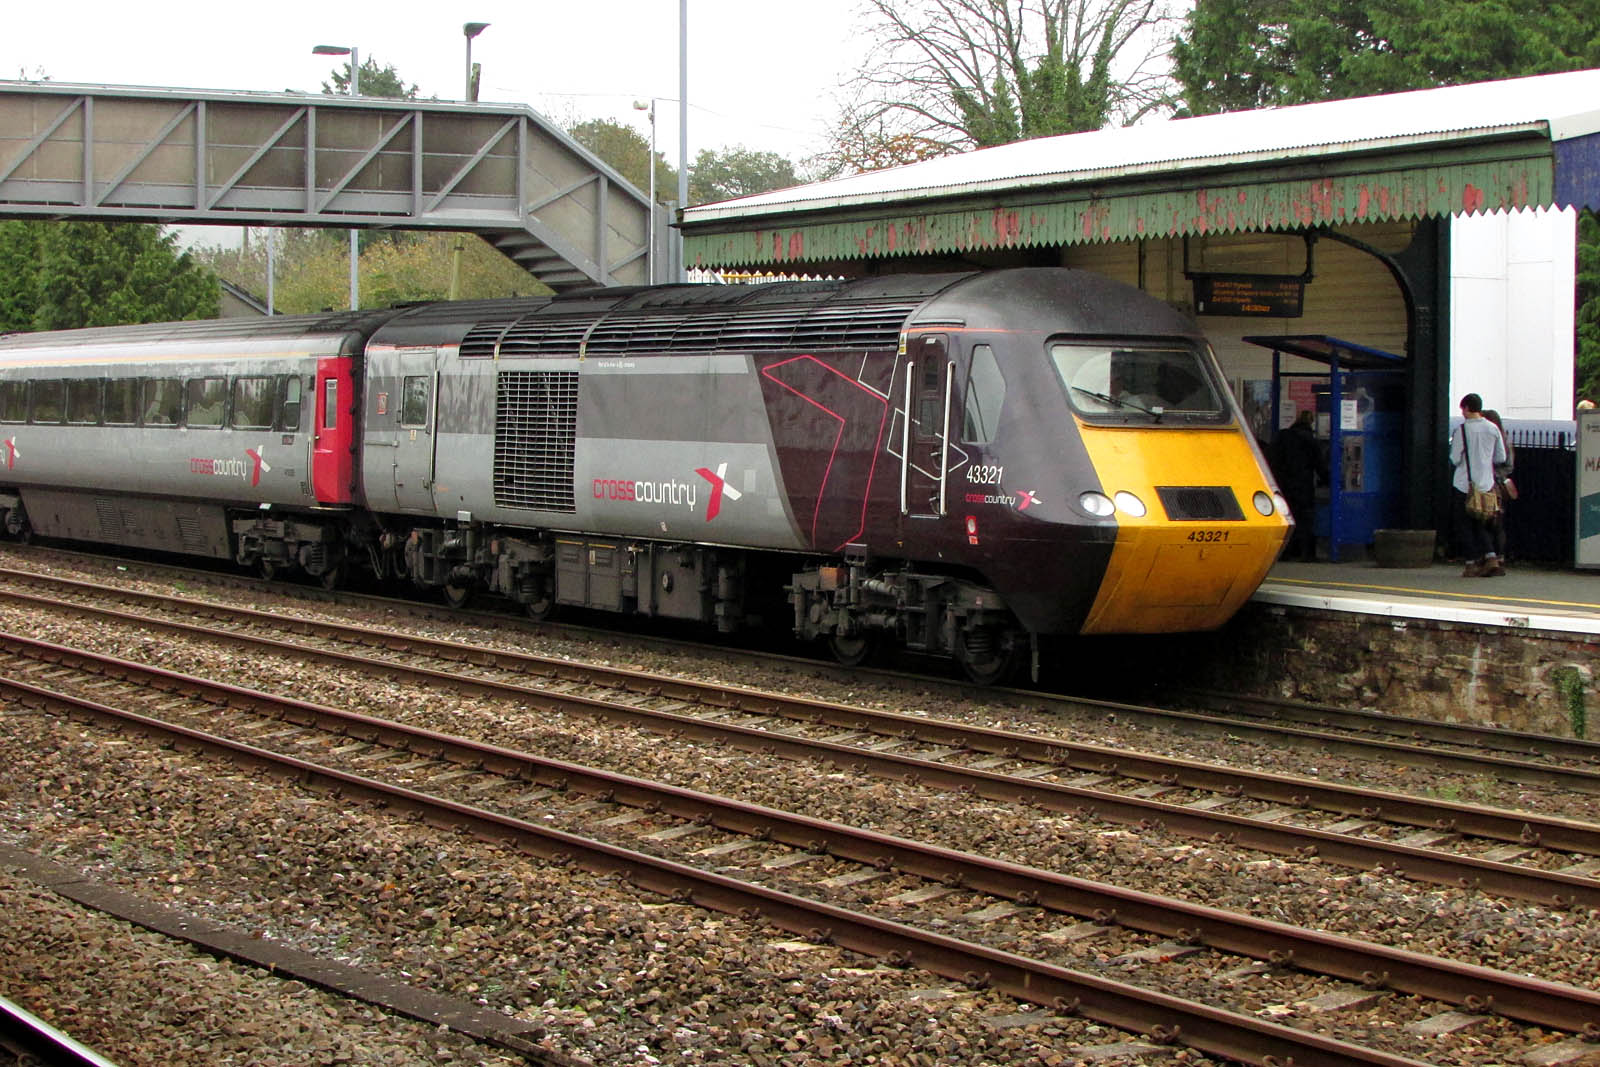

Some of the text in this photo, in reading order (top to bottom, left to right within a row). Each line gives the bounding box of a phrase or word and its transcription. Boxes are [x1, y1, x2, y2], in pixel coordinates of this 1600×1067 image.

[191, 457, 247, 480] crosscountry
[966, 465, 1003, 484] 43321
[592, 479, 696, 511] crosscountry
[1187, 530, 1229, 542] 43321
